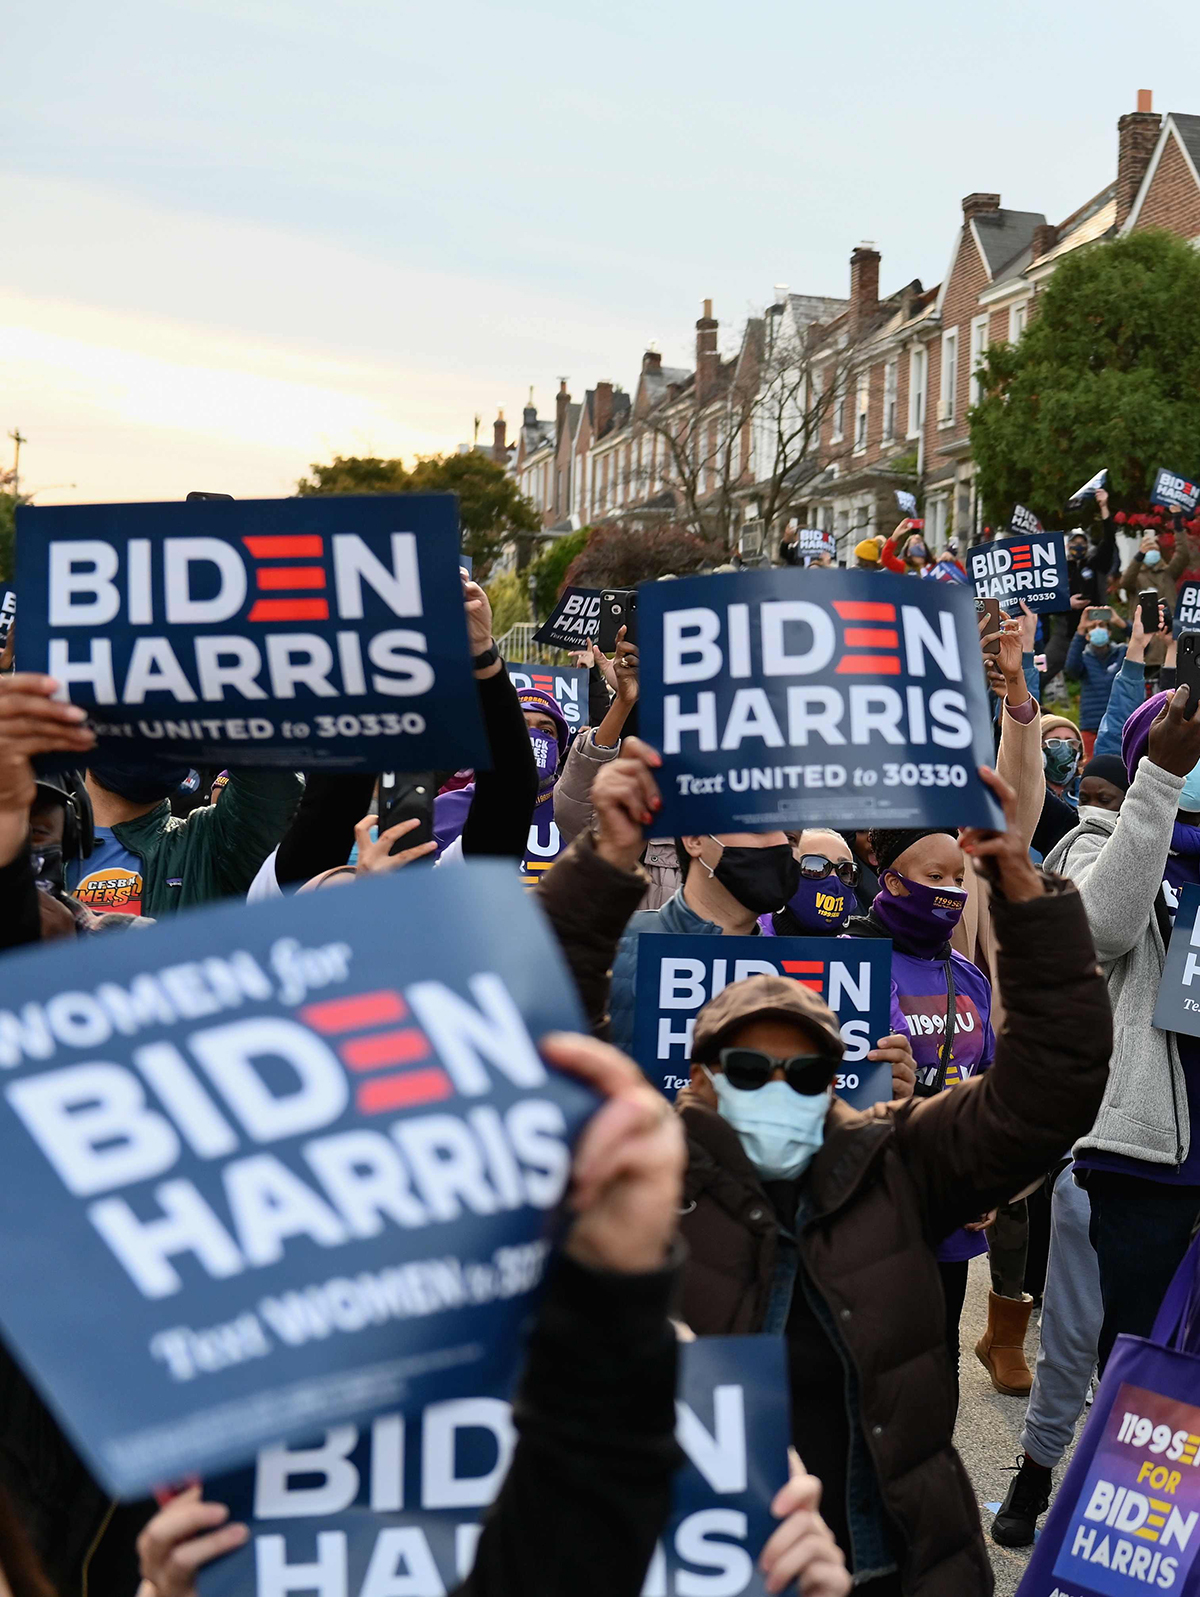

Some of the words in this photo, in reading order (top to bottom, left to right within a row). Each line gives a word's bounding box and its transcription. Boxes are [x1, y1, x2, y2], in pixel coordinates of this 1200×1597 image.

[1156, 484, 1197, 508] HARRIS
[1159, 473, 1200, 499] BIDEN
[1012, 504, 1041, 530] BID
[972, 542, 1057, 579] BIDEN
[48, 532, 424, 627] BIDEN
[975, 568, 1059, 599] HARRIS
[562, 594, 600, 617] BID
[1027, 592, 1056, 603] 30330
[552, 614, 600, 636] HAR
[662, 600, 963, 685] BIDEN
[48, 629, 436, 706] HARRIS
[508, 672, 579, 701] DEN
[139, 719, 274, 740] UNITED
[282, 720, 310, 739] to
[314, 712, 427, 738] 30330
[662, 684, 973, 755] HARRIS
[529, 737, 549, 750] ACK
[676, 773, 725, 796] Text
[728, 764, 848, 792] UNITED
[853, 768, 878, 787] to
[882, 762, 969, 788] 30330
[815, 892, 844, 911] VOTE
[270, 936, 353, 1006] for
[6, 971, 548, 1198] BIDEN
[88, 1099, 570, 1299] HARRIS
[254, 1385, 747, 1520] BIDN
[1136, 1460, 1182, 1494] FOR
[1083, 1479, 1199, 1552] BIDEN
[1071, 1525, 1179, 1589] HARRIS
